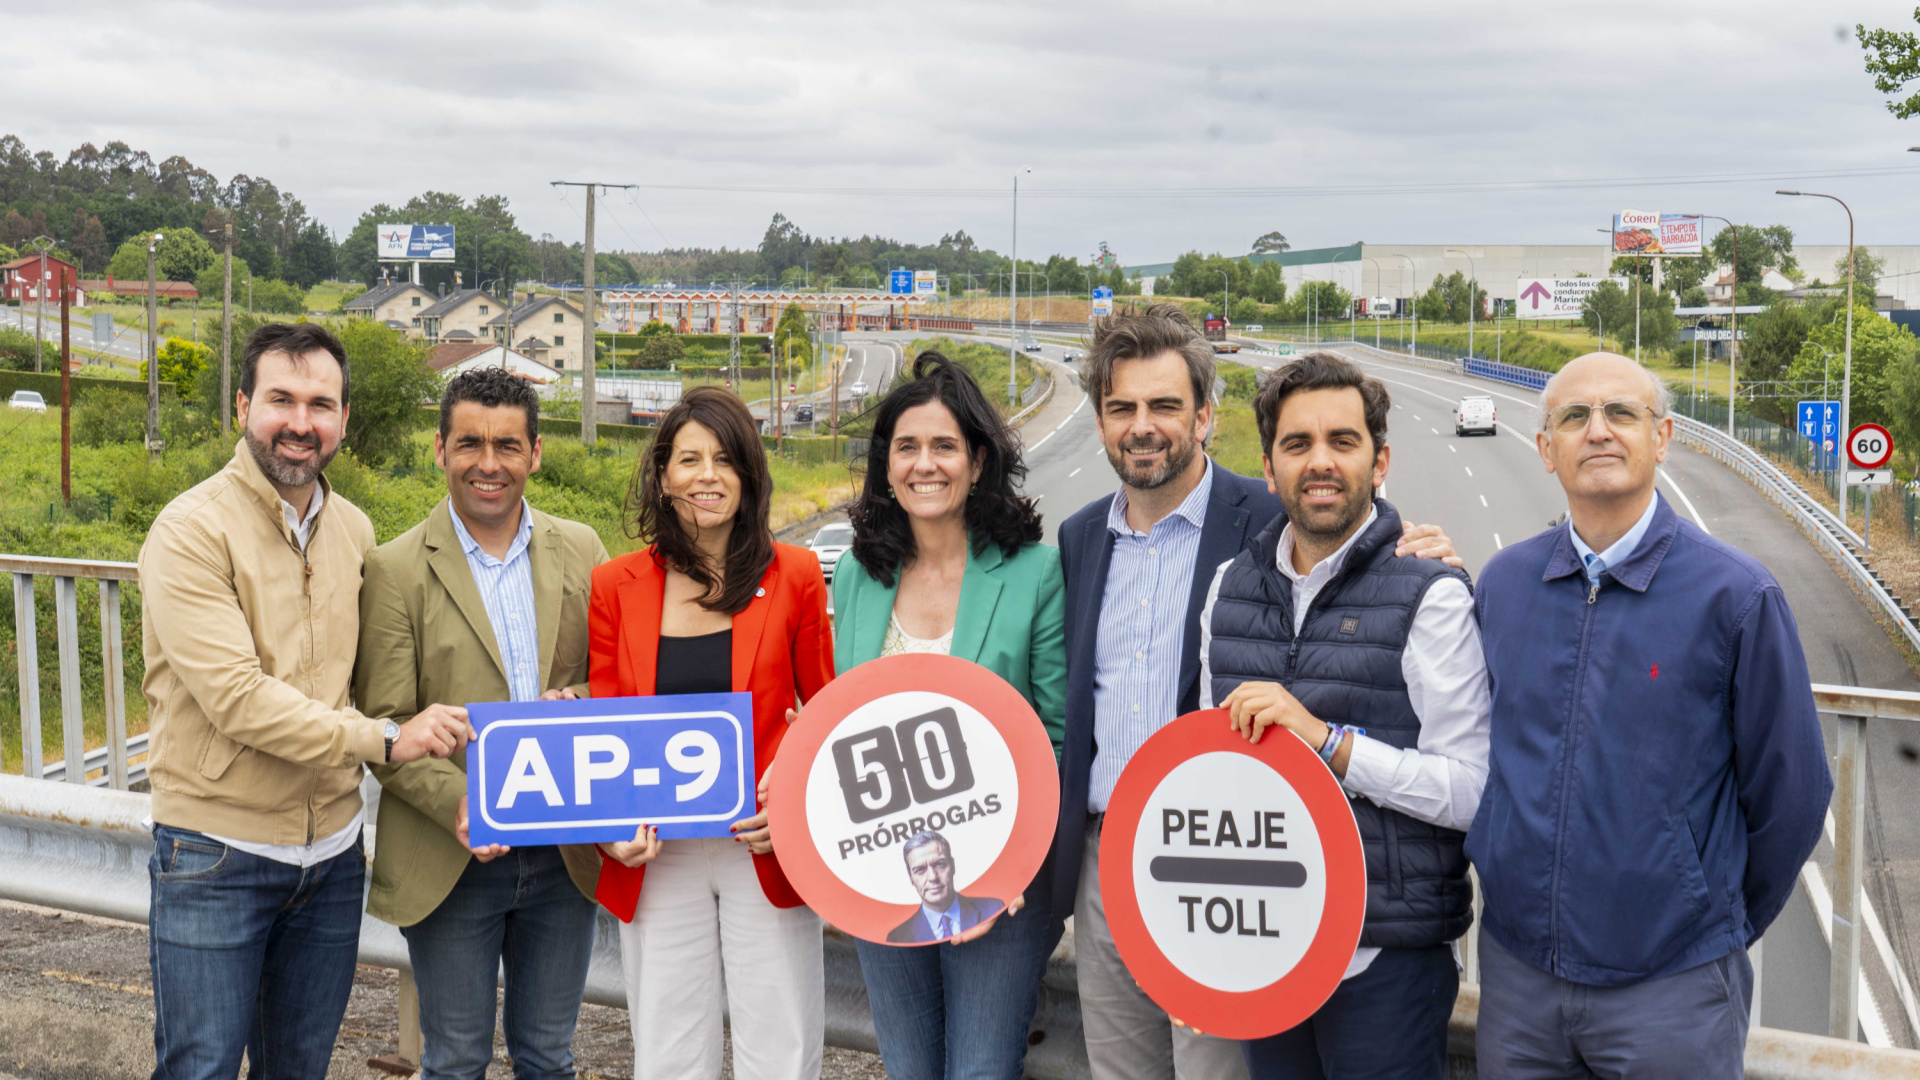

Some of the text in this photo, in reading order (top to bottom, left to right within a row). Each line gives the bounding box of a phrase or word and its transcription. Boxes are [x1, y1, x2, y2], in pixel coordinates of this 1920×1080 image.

[1661, 233, 1698, 245] BARBACOA
[1666, 224, 1688, 234] TEMPO
[1689, 222, 1698, 232] DE
[1857, 439, 1882, 453] 60
[495, 730, 721, 809] AP-9
[851, 721, 956, 810] 50
[838, 793, 1002, 860] PRÓRROGAS
[1162, 808, 1288, 850] PEAJE
[1178, 895, 1280, 938] TOLL
